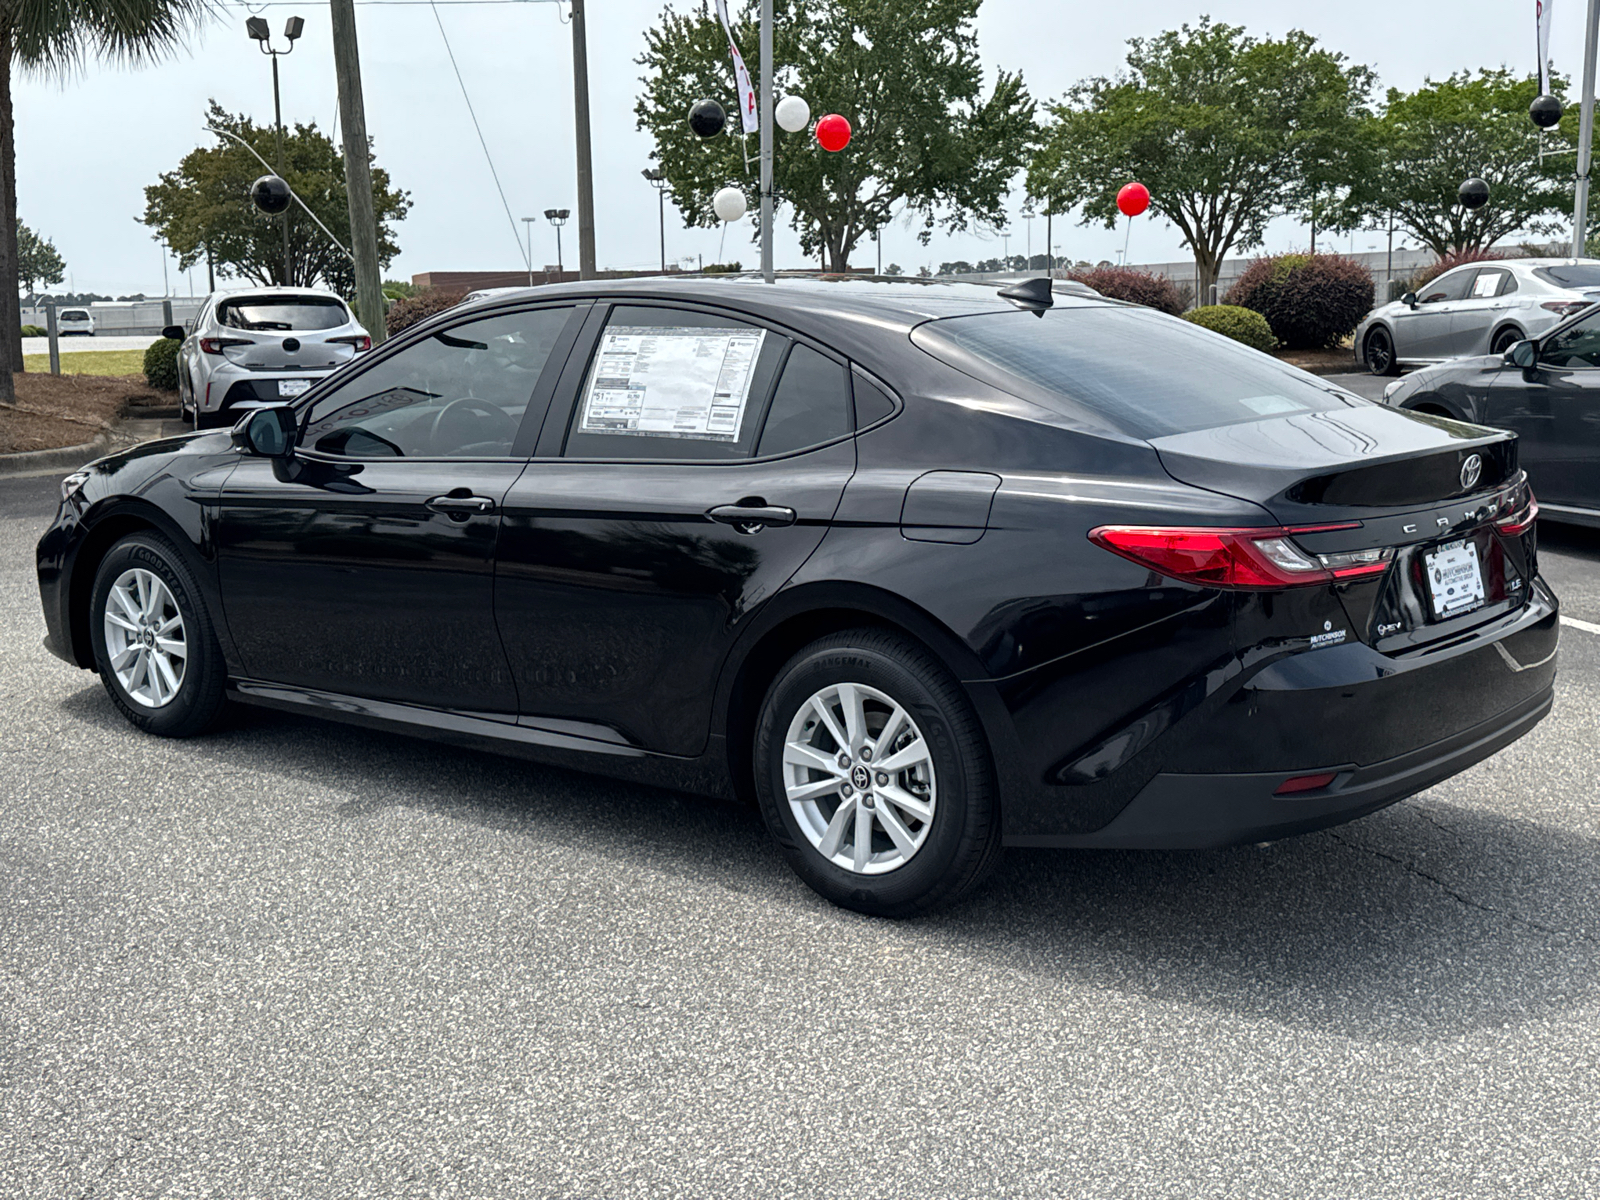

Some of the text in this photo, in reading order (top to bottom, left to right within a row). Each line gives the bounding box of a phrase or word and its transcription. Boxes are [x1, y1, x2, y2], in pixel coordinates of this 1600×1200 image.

[1402, 497, 1515, 534] CAMRY
[138, 549, 188, 606] GOODYEAR
[1511, 578, 1522, 592] LE
[1310, 629, 1347, 644] HUTCHINSON
[813, 656, 872, 671] RANGEMAX
